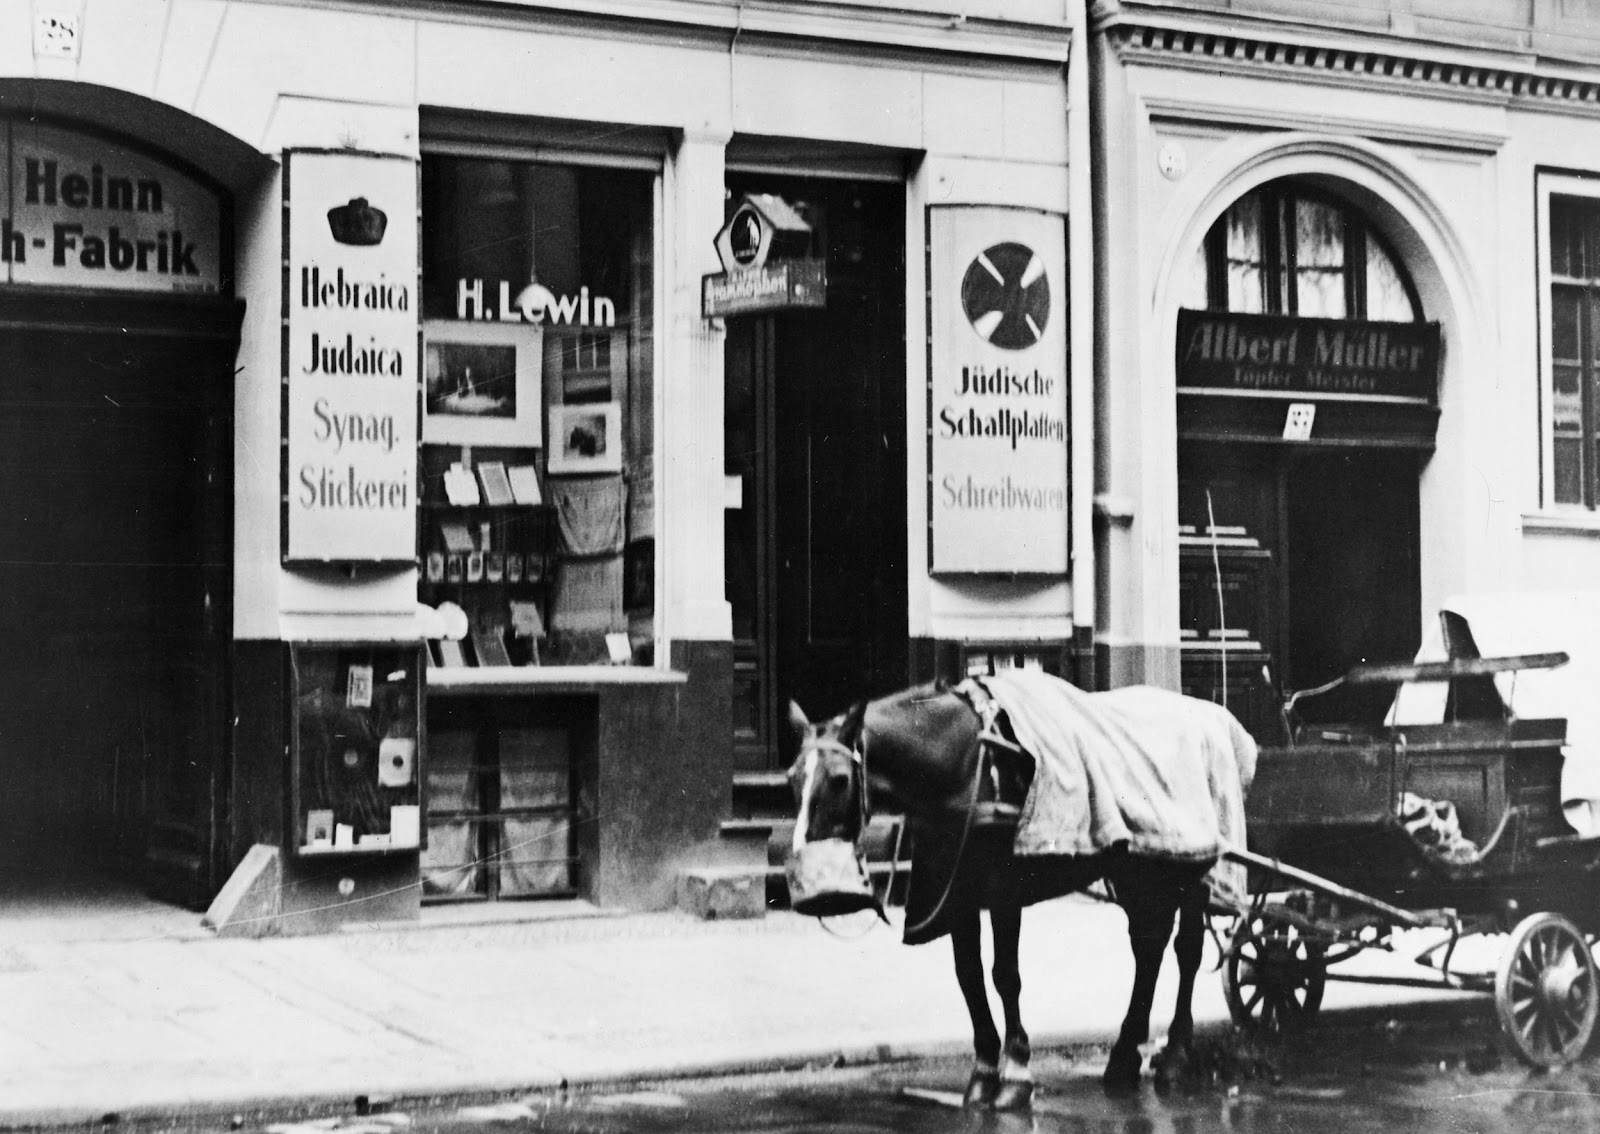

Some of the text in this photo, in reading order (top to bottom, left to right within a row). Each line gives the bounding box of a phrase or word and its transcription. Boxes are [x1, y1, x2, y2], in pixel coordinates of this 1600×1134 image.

[25, 157, 164, 214] Heinn
[301, 266, 408, 312] Hebraica
[302, 332, 403, 376] Judaica
[1184, 322, 1425, 372] Albert Müller
[954, 364, 1054, 397] Jüdische
[312, 397, 399, 455] Synag.
[939, 404, 1064, 451] Schallplatten
[299, 464, 407, 509] Stickerei
[942, 472, 1064, 510] Schreibwaren
